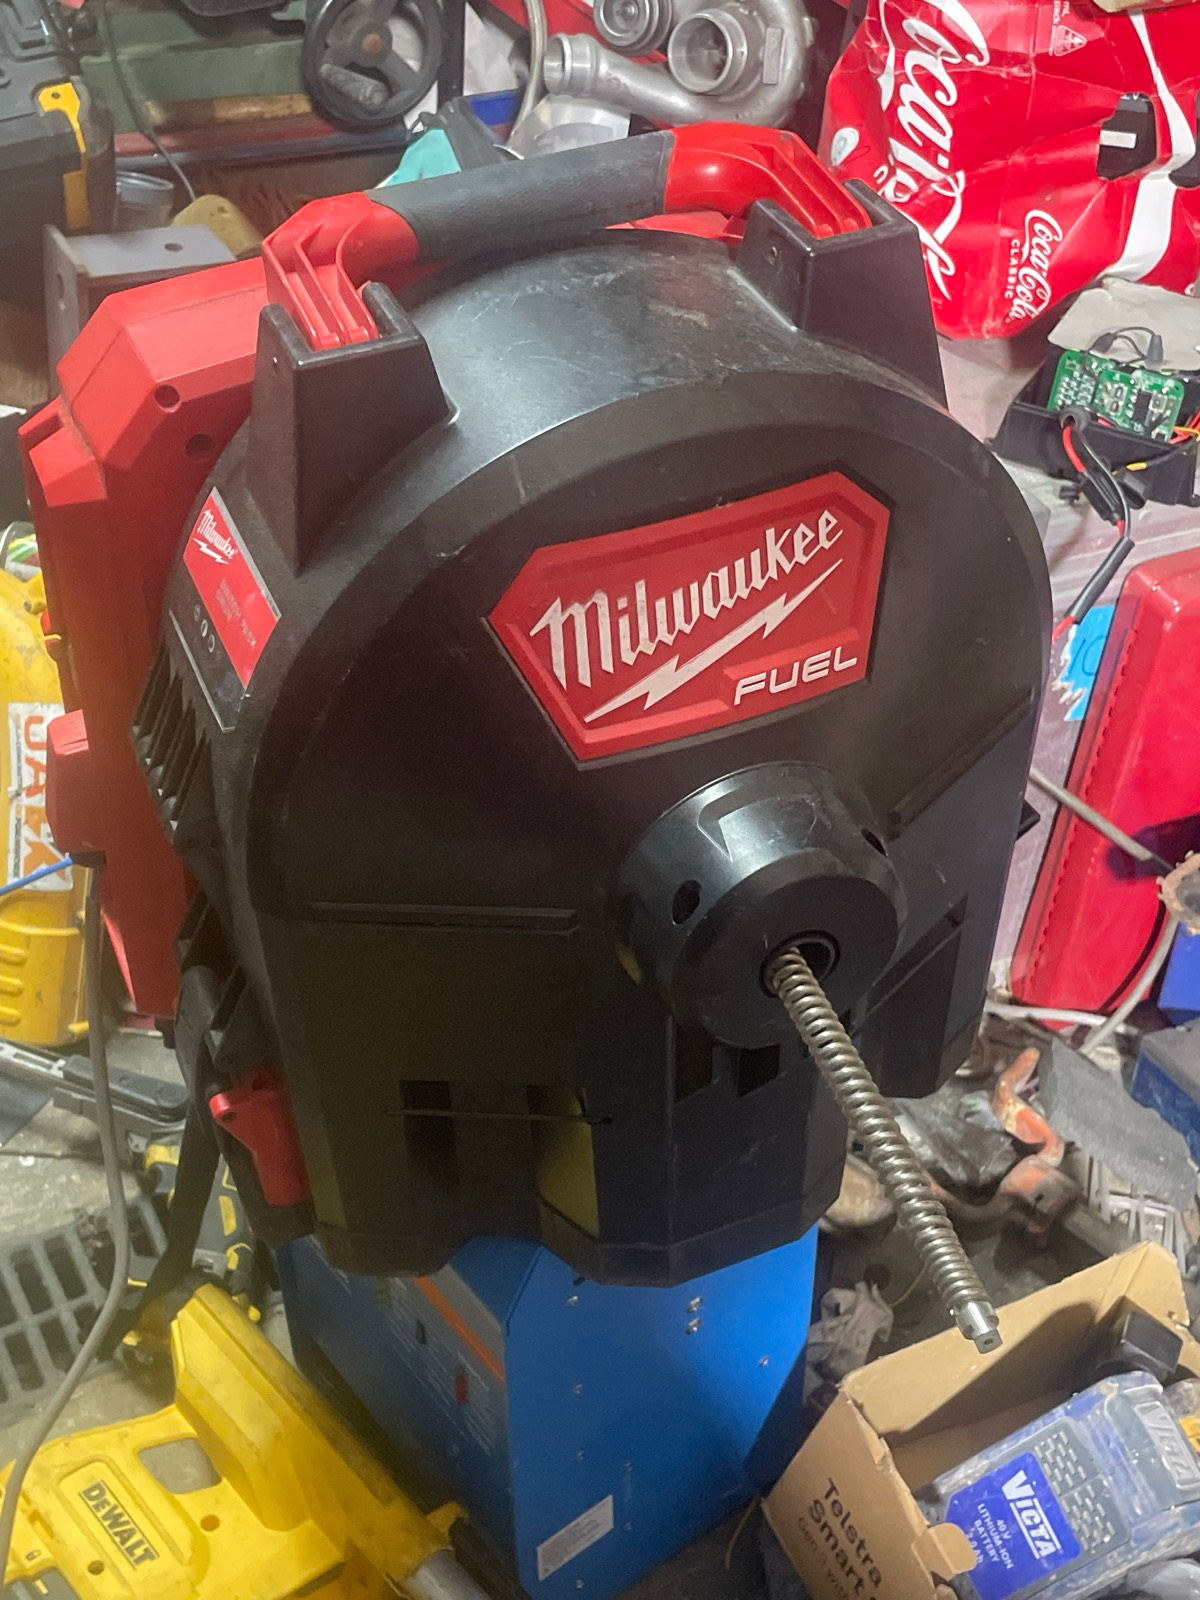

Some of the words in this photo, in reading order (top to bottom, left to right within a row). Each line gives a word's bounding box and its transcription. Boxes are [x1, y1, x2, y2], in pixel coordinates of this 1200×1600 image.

[1004, 239, 1021, 299] CLASSIC
[1008, 209, 1063, 319] Coca-Cola
[198, 509, 236, 560] Milwaukee
[529, 510, 843, 690] Milwaukee
[734, 646, 858, 706] FUEL
[810, 1500, 865, 1596] Smart
[824, 1477, 882, 1588] Telstra
[974, 1519, 1000, 1562] BATTERY
[977, 1503, 1014, 1569] LITHIUM-ION
